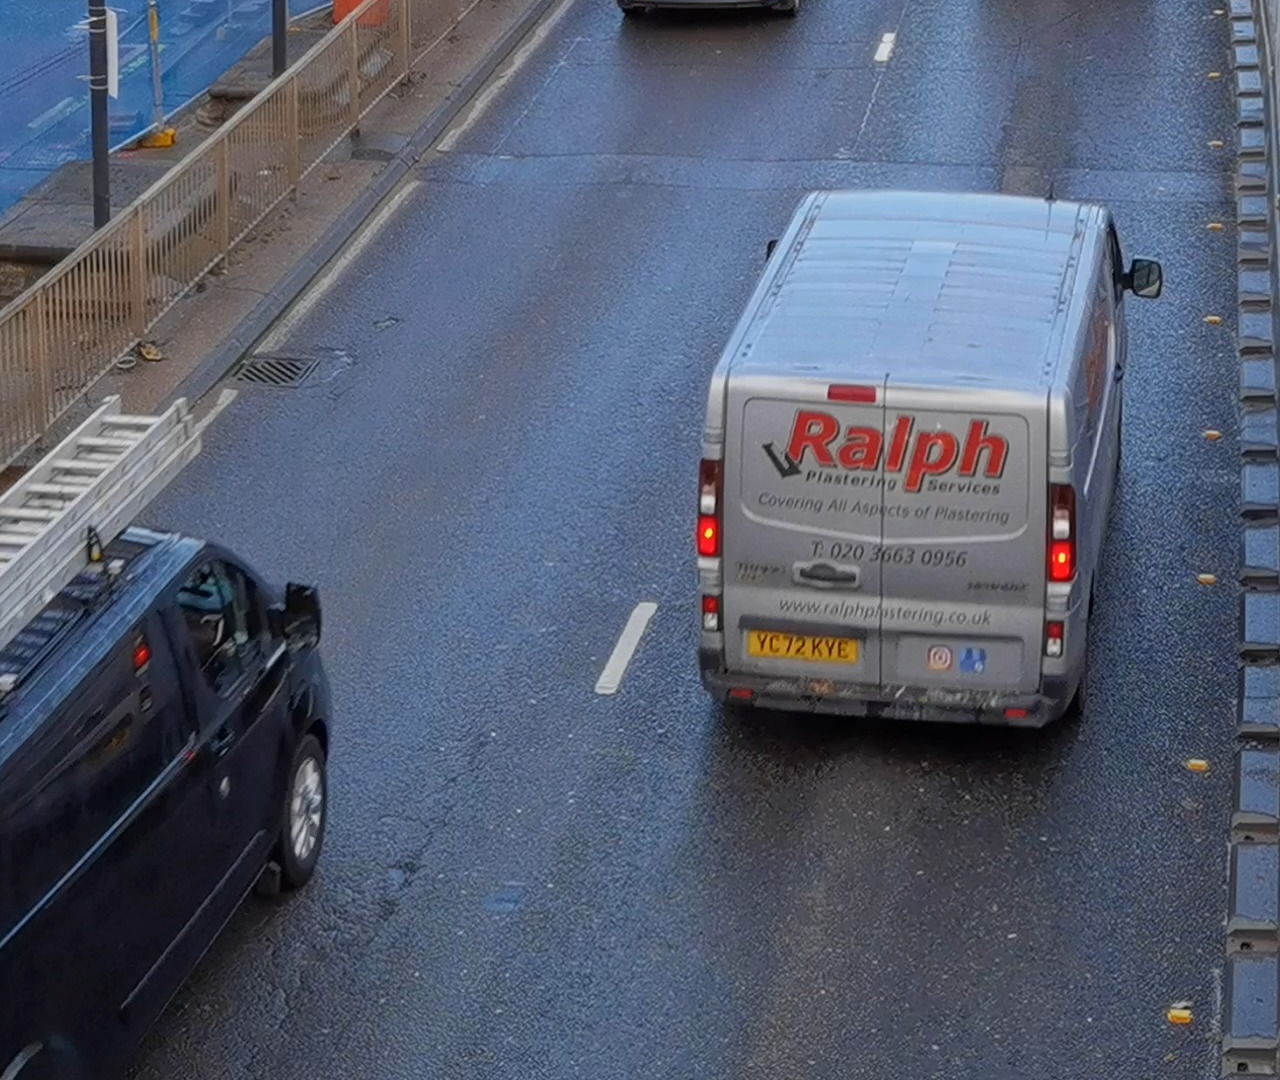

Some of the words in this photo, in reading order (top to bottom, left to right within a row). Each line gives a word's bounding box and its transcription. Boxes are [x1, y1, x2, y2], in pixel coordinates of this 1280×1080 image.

[787, 408, 1009, 494] Ralph
[805, 470, 897, 491] Plastering
[927, 479, 1001, 496] Services
[757, 492, 824, 515] Covering
[827, 499, 848, 513] All
[851, 501, 910, 520] Aspects
[914, 505, 932, 519] of
[935, 506, 1011, 526] Plastering
[829, 542, 865, 561] 020
[869, 545, 916, 565] 3663
[921, 548, 969, 568] 0956
[778, 598, 992, 627] www.ralphplastering.co.uk
[756, 632, 807, 654] YC72
[811, 636, 850, 659] KYE
